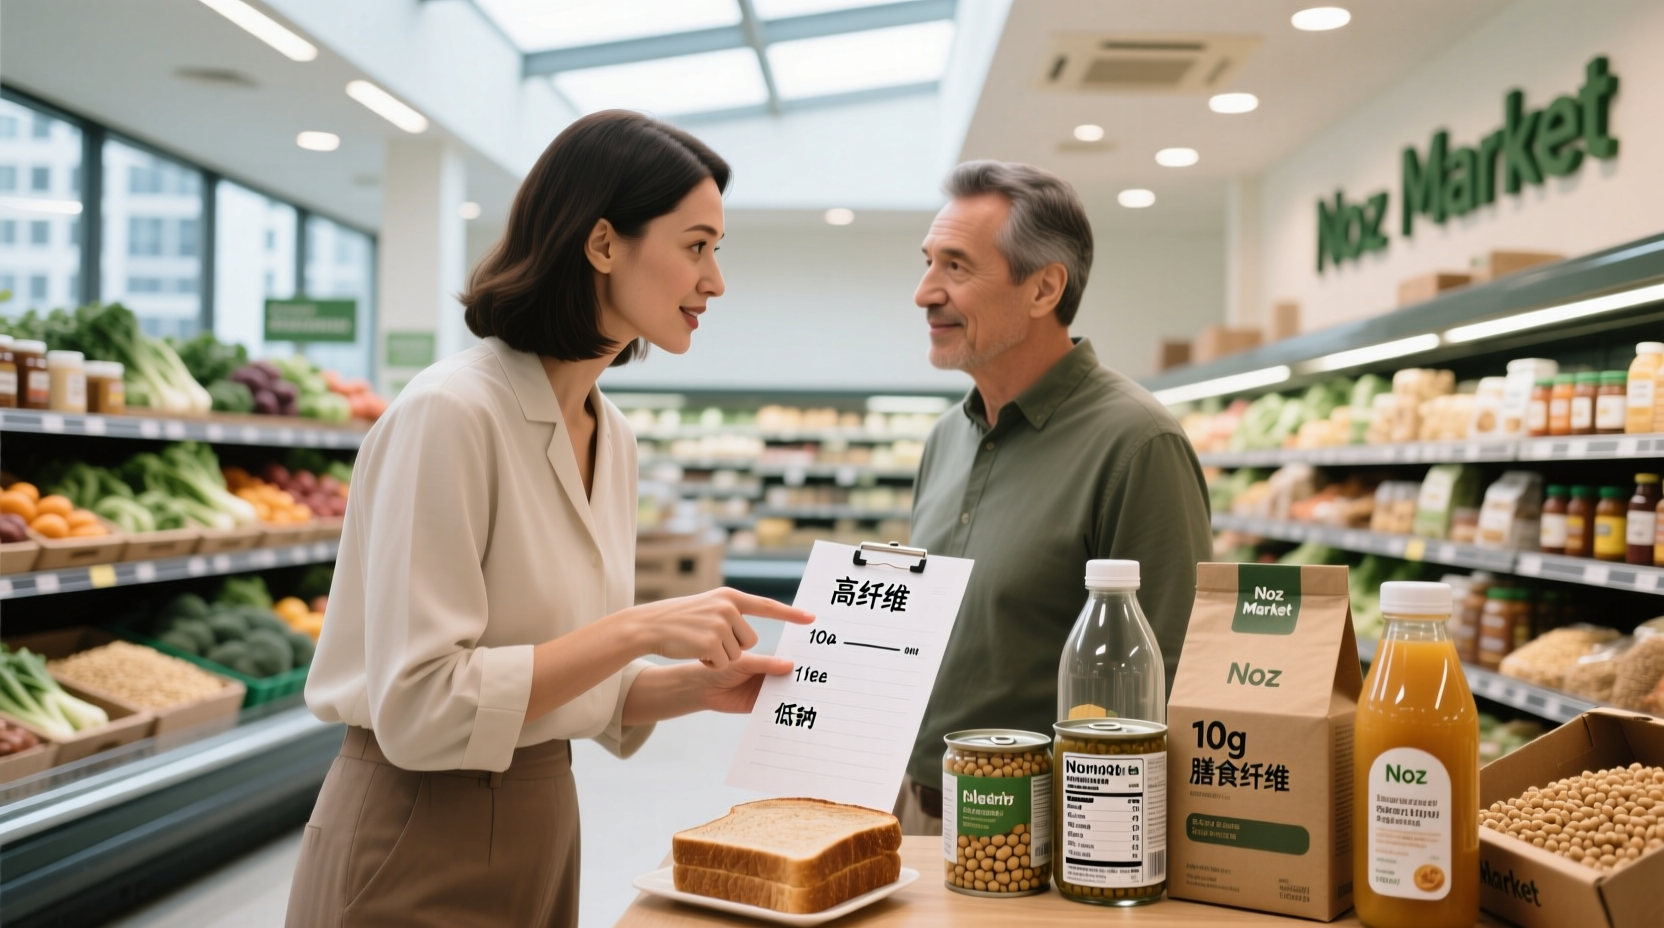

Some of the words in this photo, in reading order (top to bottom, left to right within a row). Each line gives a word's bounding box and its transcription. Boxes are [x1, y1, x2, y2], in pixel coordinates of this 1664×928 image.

[1317, 190, 1389, 273] Noz
[1401, 56, 1619, 237] Market
[830, 576, 911, 613] 高纤维
[1242, 601, 1293, 617] Market
[1254, 585, 1285, 602] Noz
[1226, 661, 1283, 688] Noz
[1192, 720, 1247, 760] 10g
[1188, 756, 1290, 793] 膳食纤维
[1385, 763, 1428, 785] Noz
